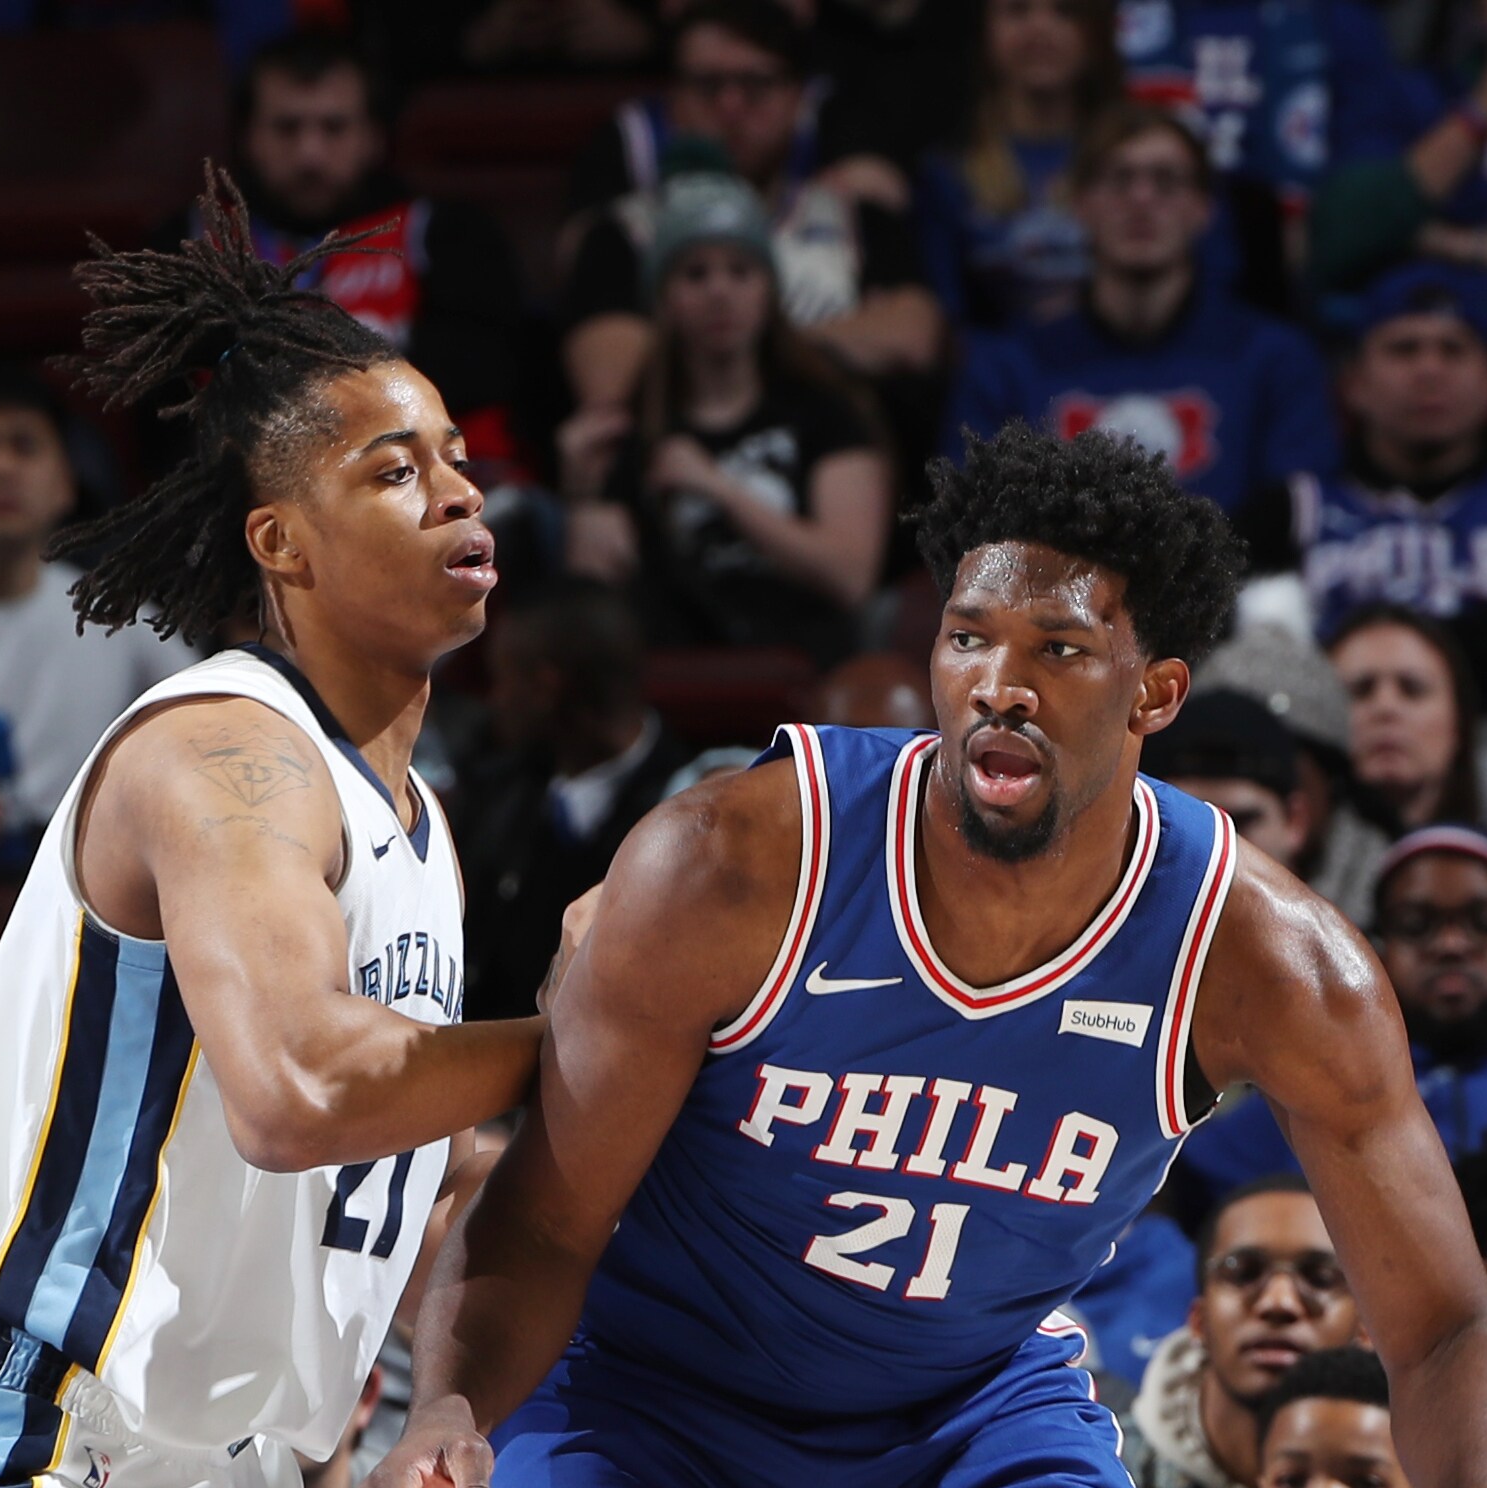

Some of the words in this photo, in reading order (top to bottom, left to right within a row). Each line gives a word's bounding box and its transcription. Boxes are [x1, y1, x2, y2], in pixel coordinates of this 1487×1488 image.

[360, 931, 464, 1024] RIZZLI
[1070, 1010, 1137, 1033] StubHub
[736, 1063, 1120, 1206] PHILA
[320, 1150, 416, 1259] 21
[802, 1190, 972, 1301] 21
